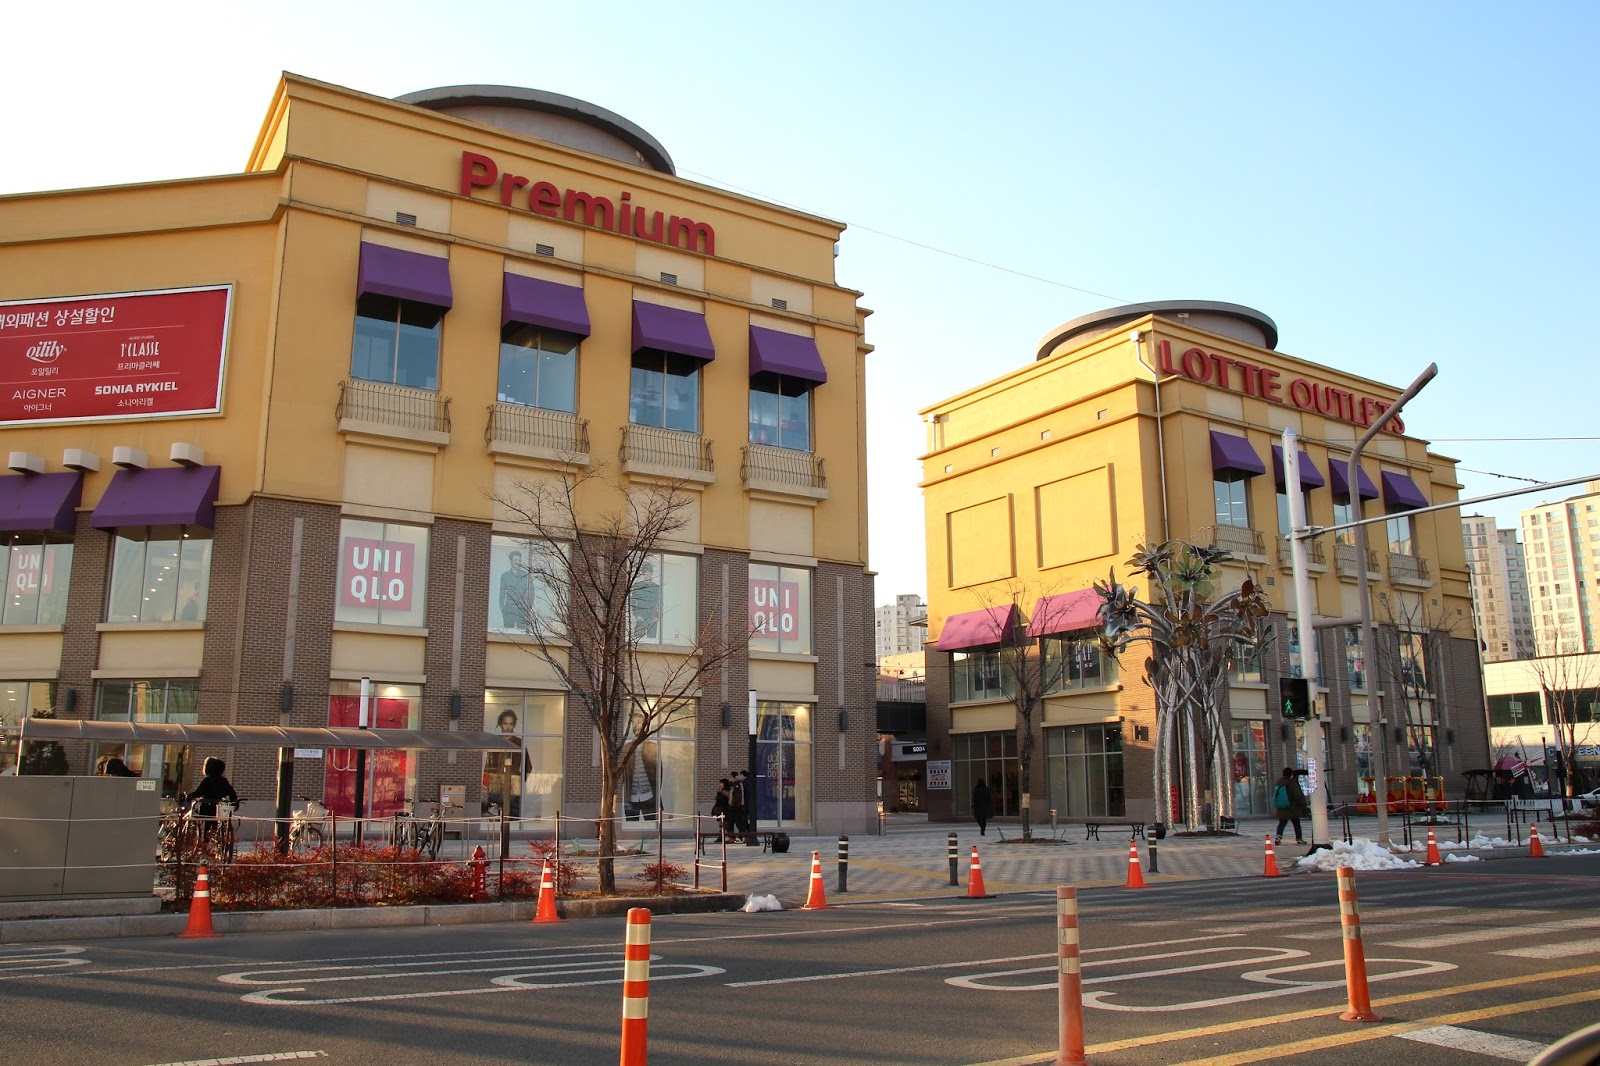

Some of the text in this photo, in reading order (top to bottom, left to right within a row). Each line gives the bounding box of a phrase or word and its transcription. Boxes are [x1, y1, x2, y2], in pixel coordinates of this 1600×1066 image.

[460, 150, 715, 255] Premium
[54, 306, 115, 327] 상설할인
[26, 340, 64, 363] oilily
[31, 367, 59, 377] 오일릴리
[12, 387, 67, 401] AIGNER
[95, 382, 179, 396] SONIA RYKIEL
[1160, 339, 1405, 435] LOTTE OUTLETS
[23, 403, 53, 413] 아이그너
[353, 546, 402, 574] UNI
[350, 575, 405, 603] QLO
[754, 586, 790, 609] UNI
[754, 611, 793, 635] QLO
